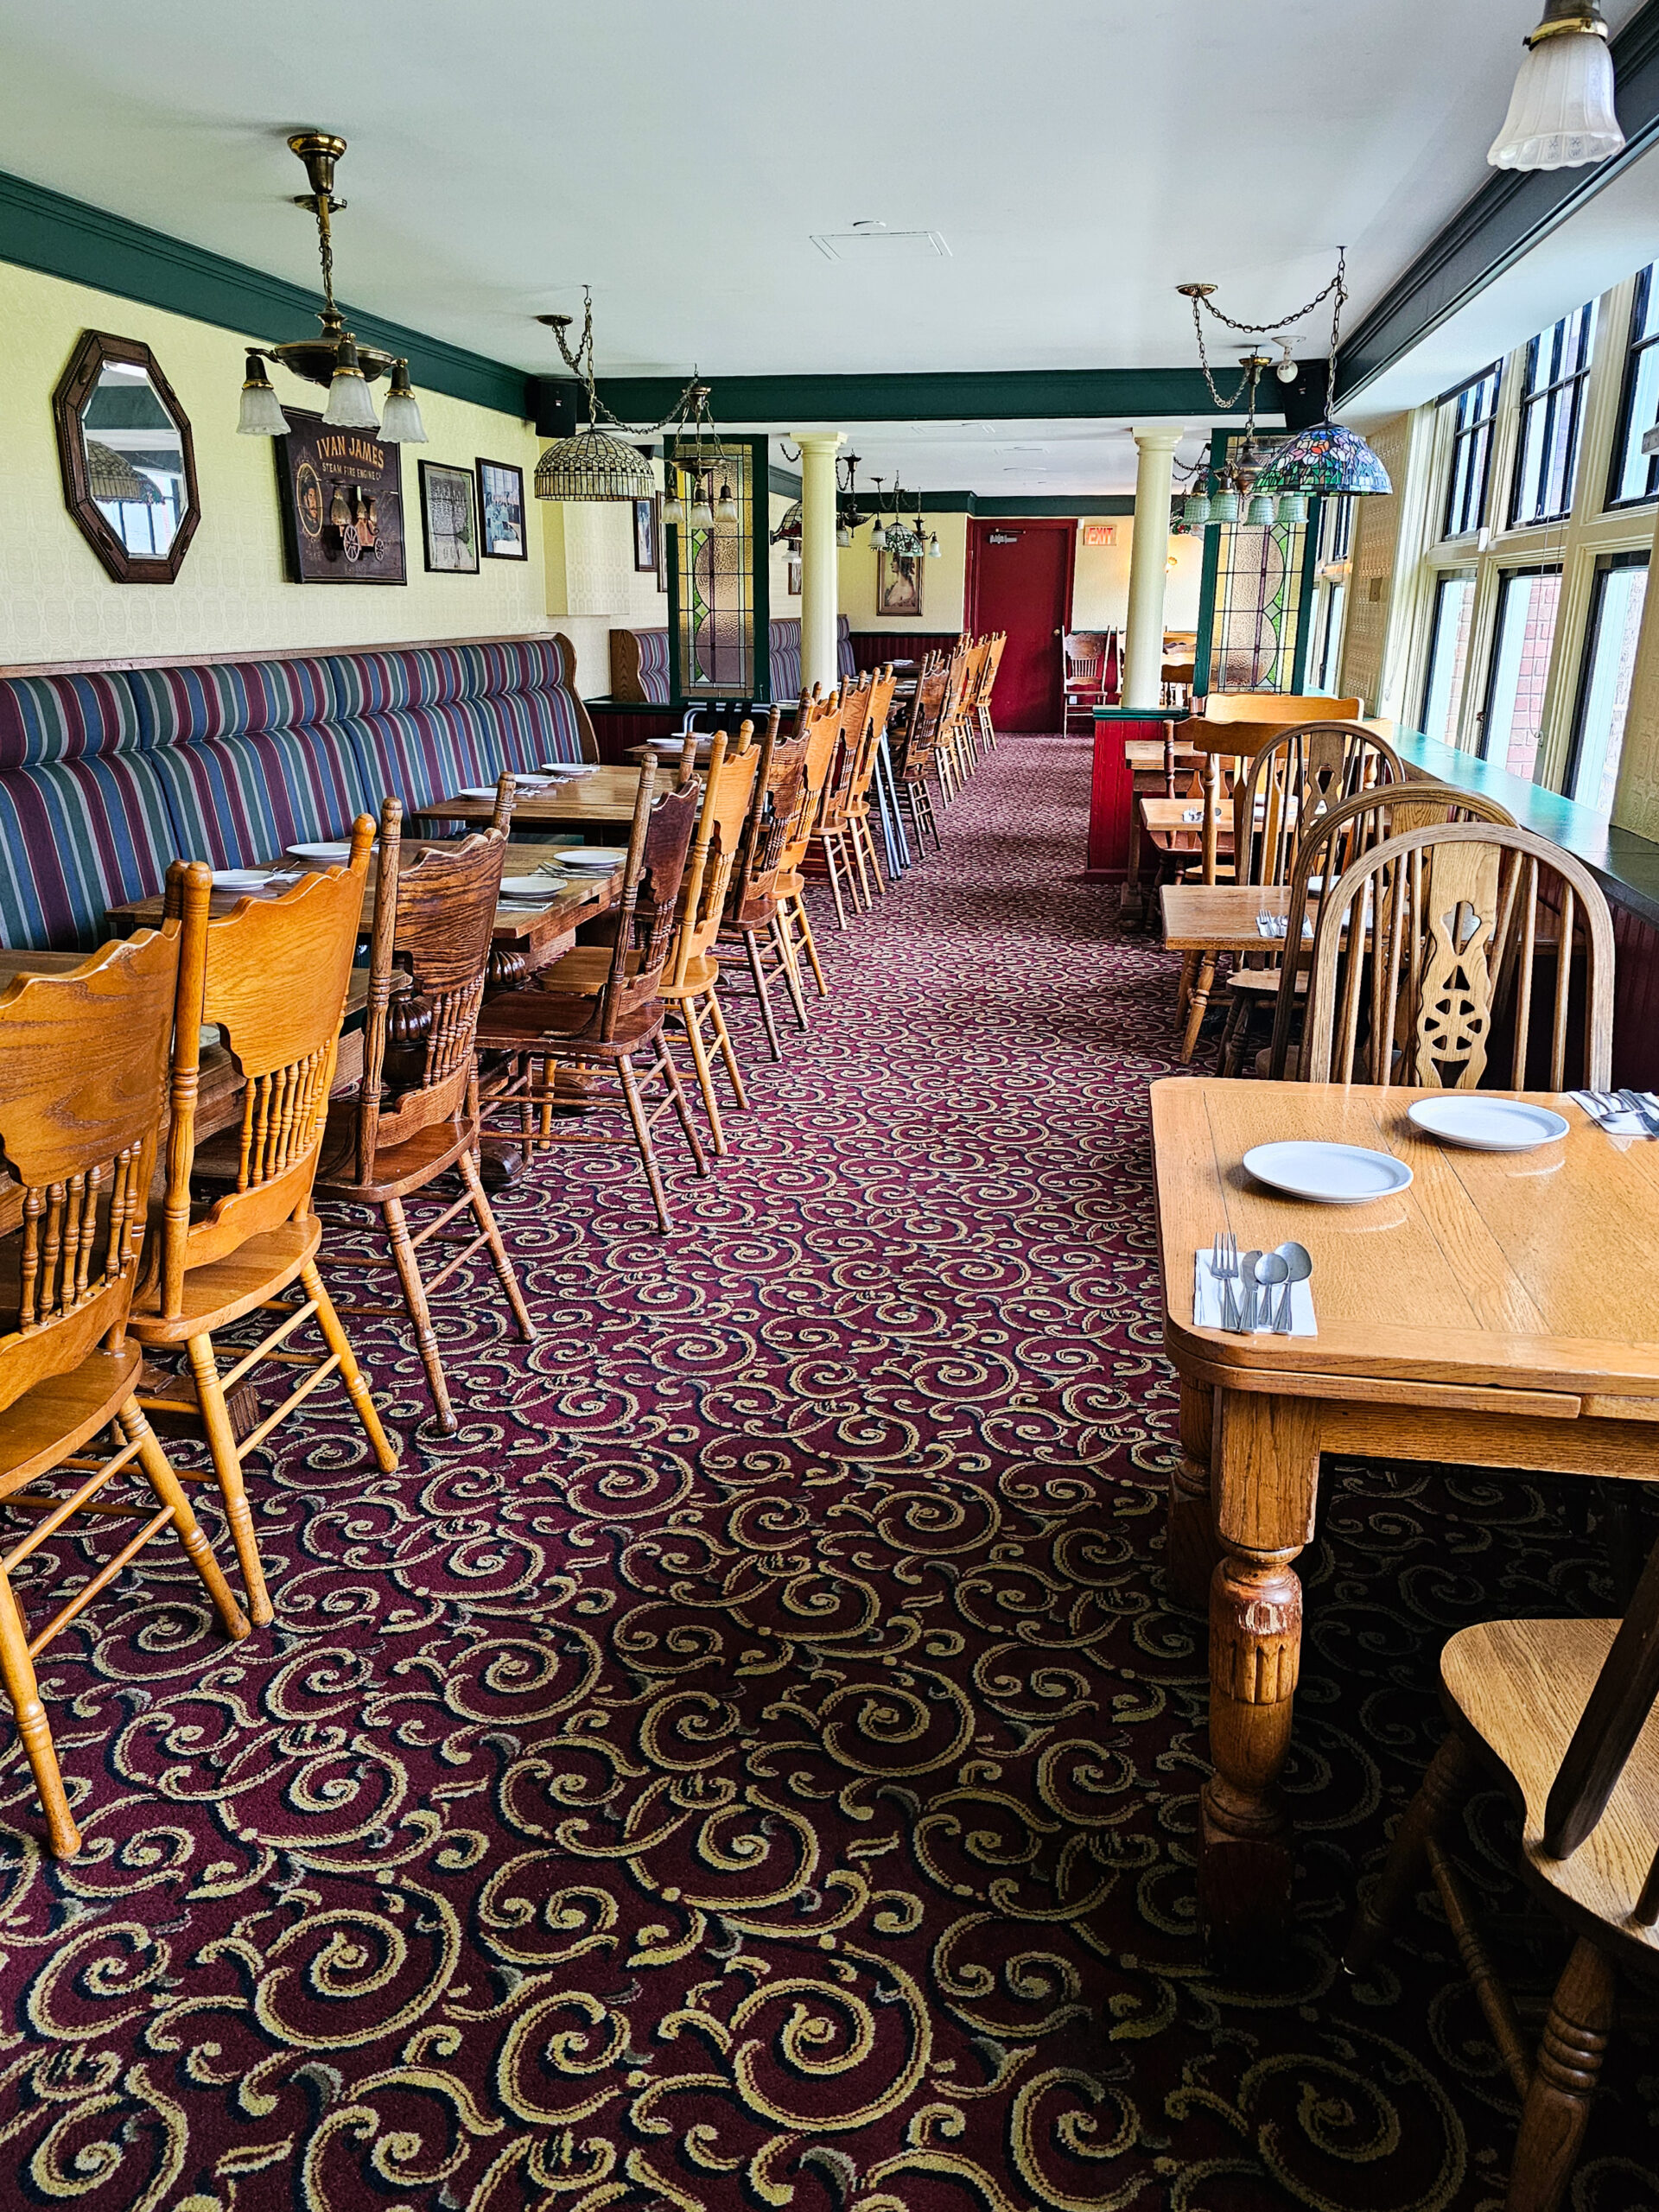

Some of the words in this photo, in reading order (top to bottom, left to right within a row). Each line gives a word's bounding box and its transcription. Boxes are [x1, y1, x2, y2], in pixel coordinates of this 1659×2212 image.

[316, 435, 346, 460] IVAN
[348, 437, 384, 470] JAMES
[322, 462, 342, 474] STEAM
[344, 466, 356, 478] FIRE
[1088, 527, 1113, 544] EXIT
